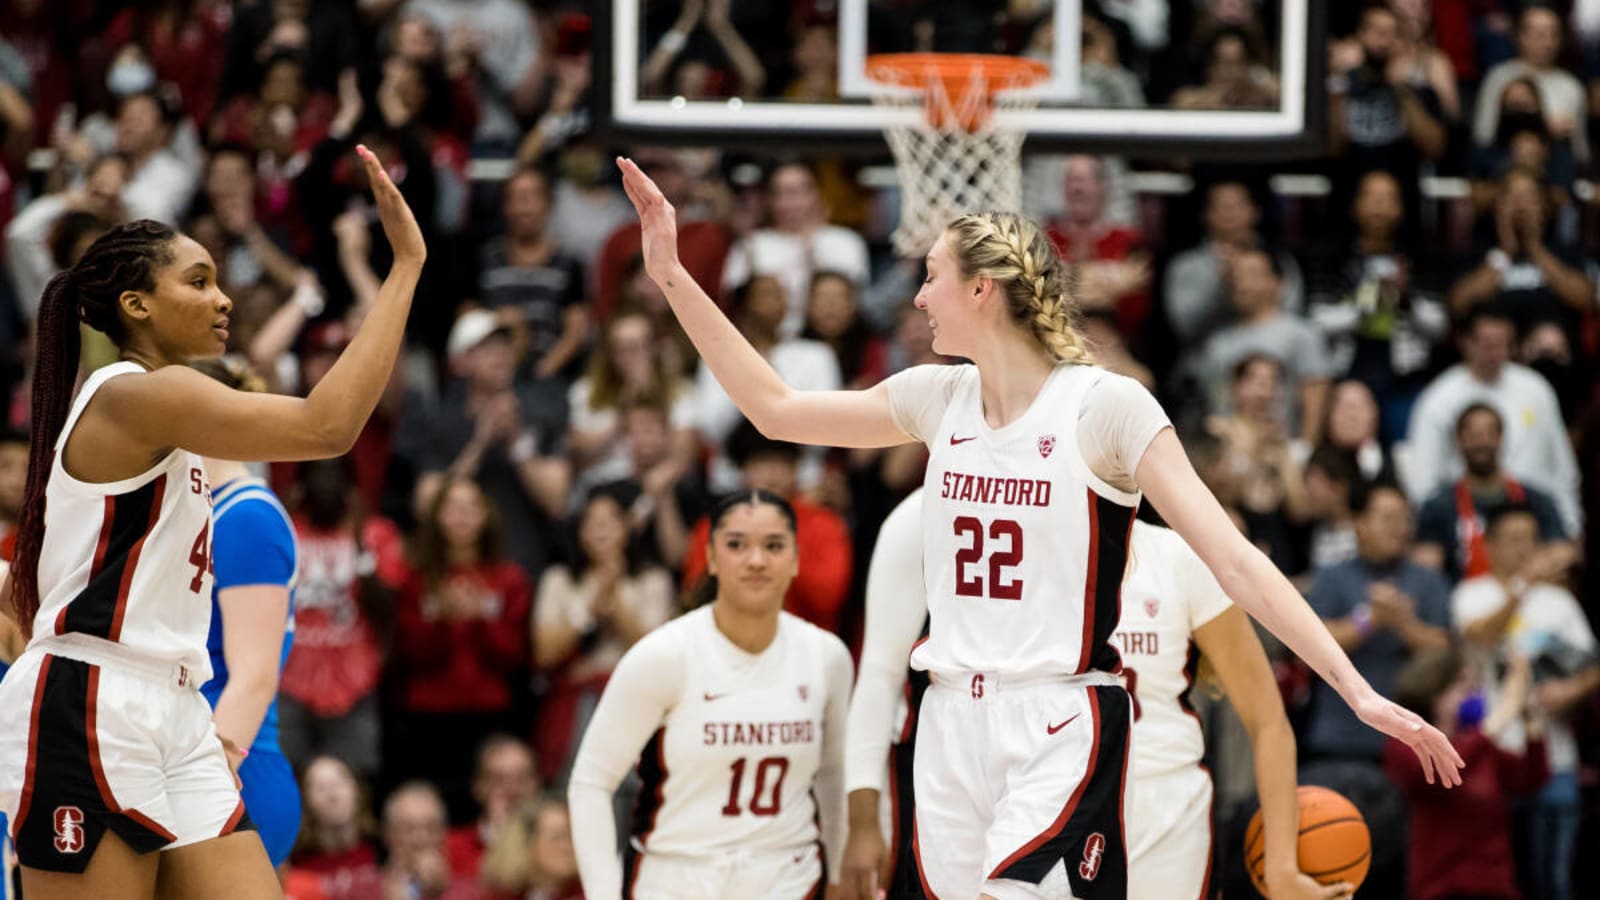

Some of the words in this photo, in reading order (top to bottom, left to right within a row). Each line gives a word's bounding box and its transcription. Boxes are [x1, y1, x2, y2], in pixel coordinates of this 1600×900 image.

[942, 471, 1052, 507] STANFORD
[953, 516, 1024, 600] 22
[703, 720, 815, 746] STANFORD
[721, 757, 790, 816] 10
